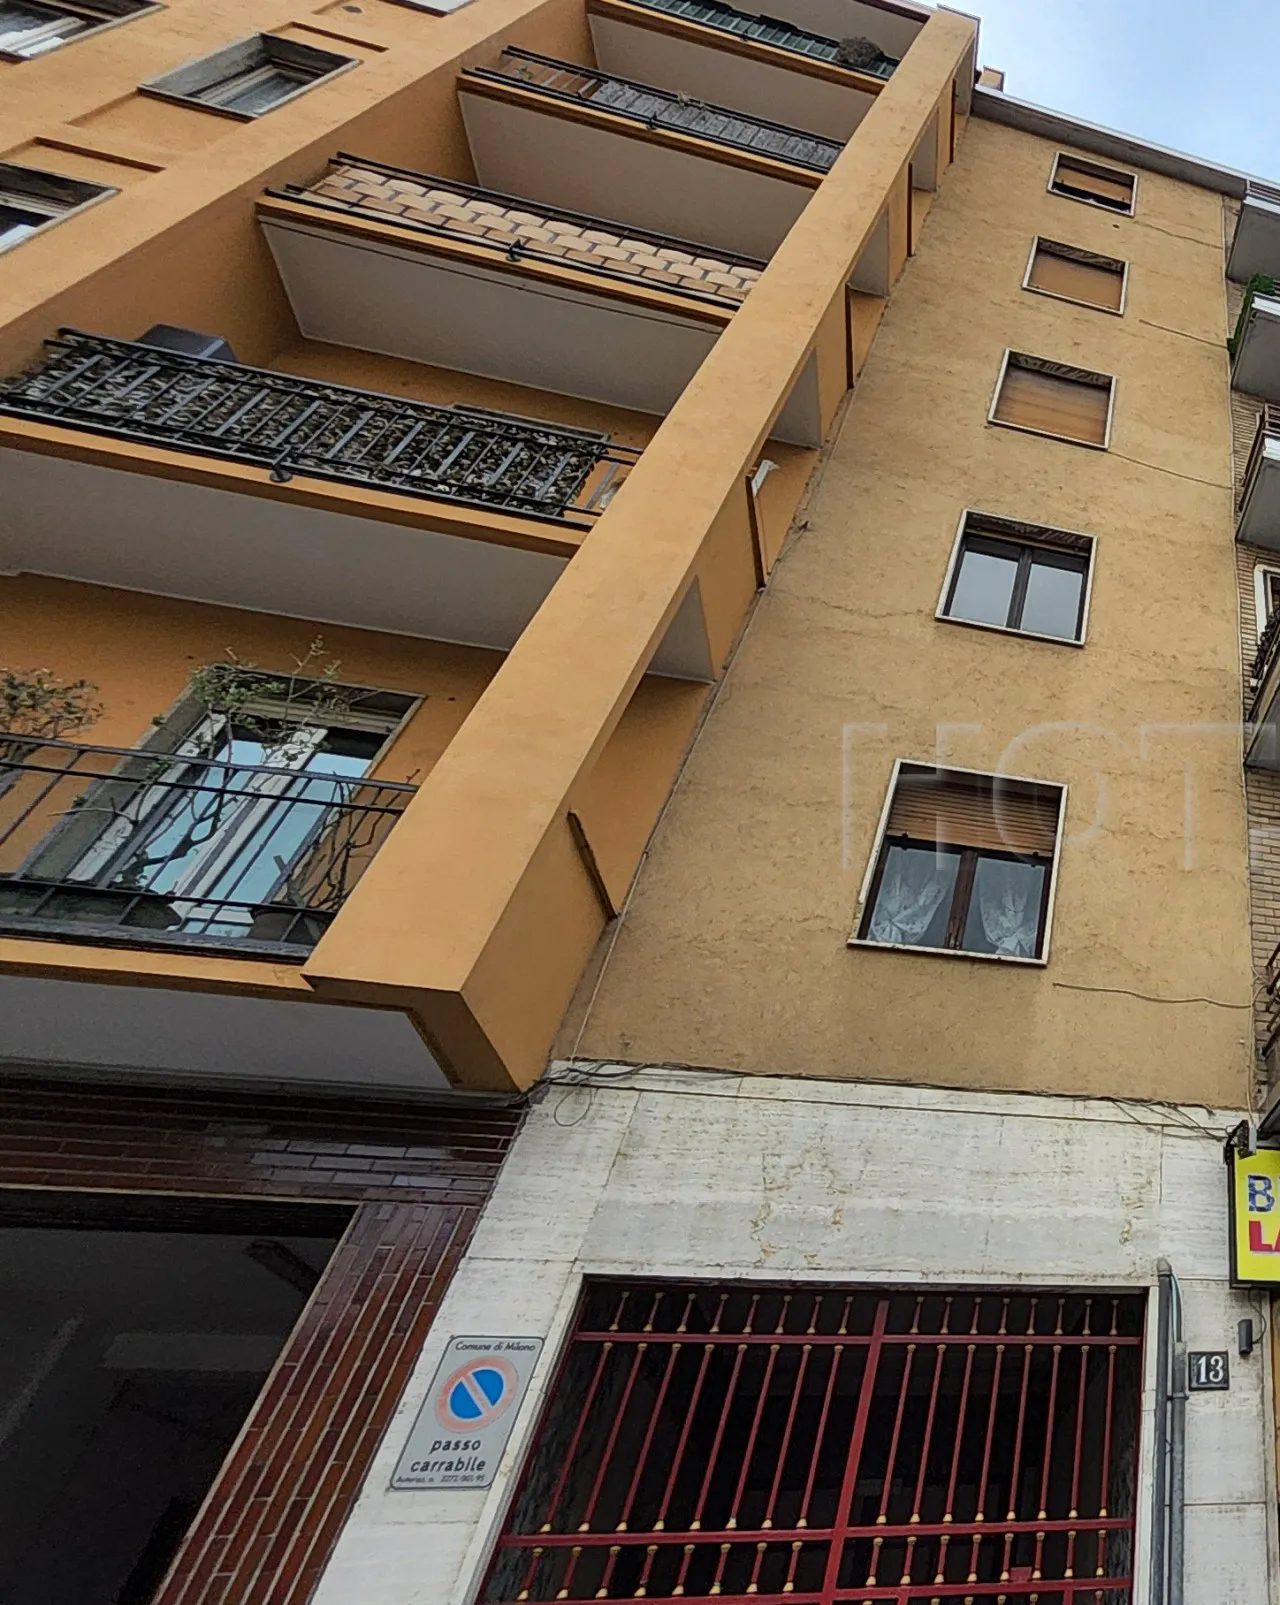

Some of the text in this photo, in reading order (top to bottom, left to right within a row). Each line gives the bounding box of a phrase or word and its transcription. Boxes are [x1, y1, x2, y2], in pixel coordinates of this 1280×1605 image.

[455, 1341, 536, 1351] Comune di Milano
[1197, 1355, 1224, 1383] 13
[428, 1439, 482, 1455] passo
[410, 1456, 486, 1473] carrabile
